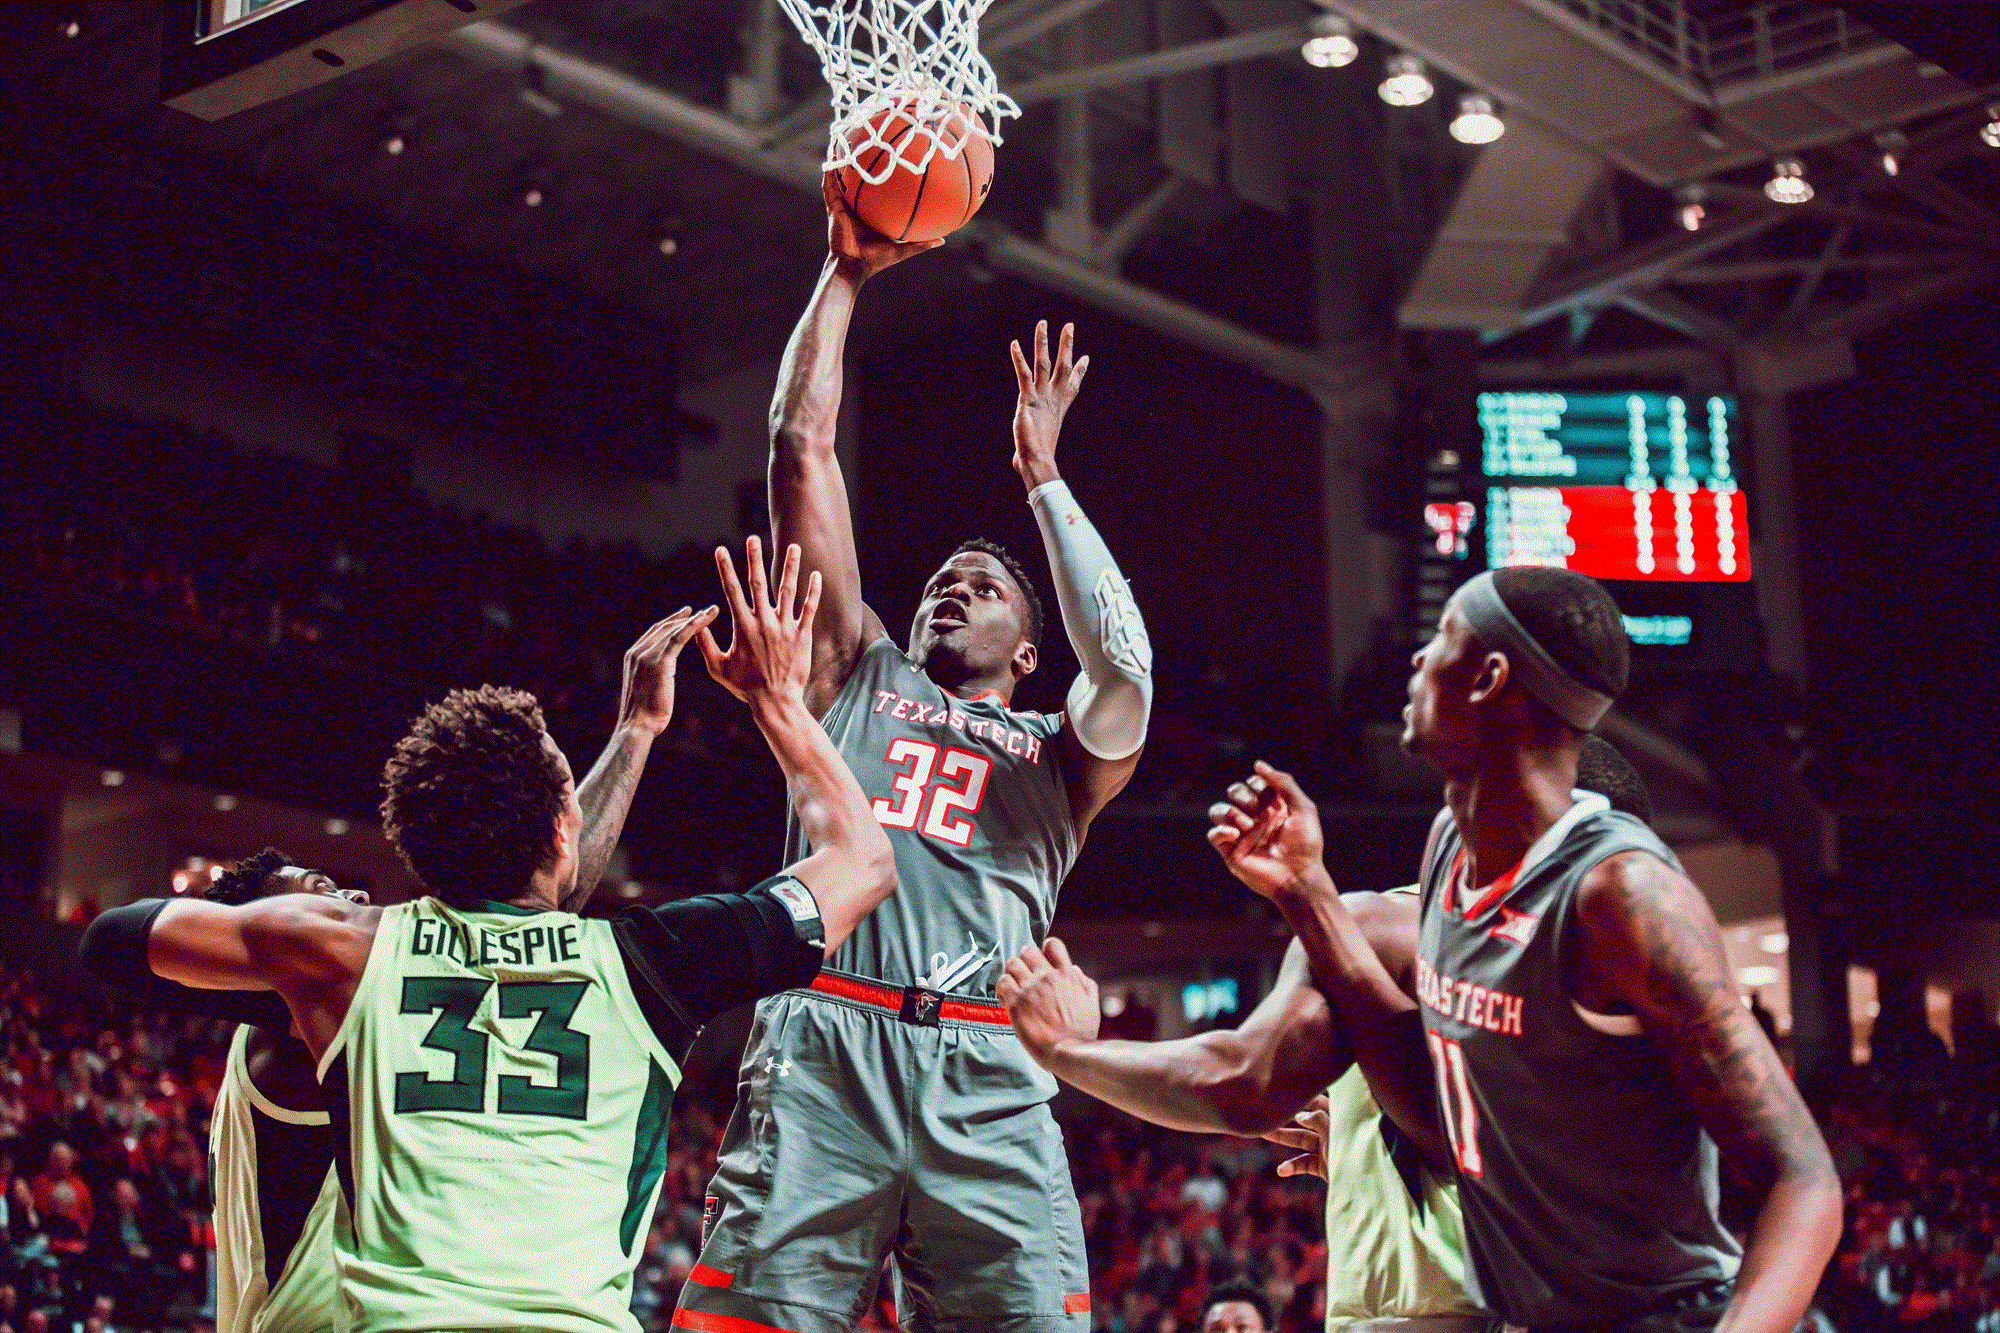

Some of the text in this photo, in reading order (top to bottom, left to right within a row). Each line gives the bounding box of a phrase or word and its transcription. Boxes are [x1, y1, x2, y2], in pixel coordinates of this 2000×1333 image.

[874, 689, 1042, 765] TEXAS TECH
[871, 736, 994, 848] 32
[412, 917, 581, 968] GILLESPIE
[1454, 978, 1524, 1037] TECH
[394, 976, 592, 1121] 33
